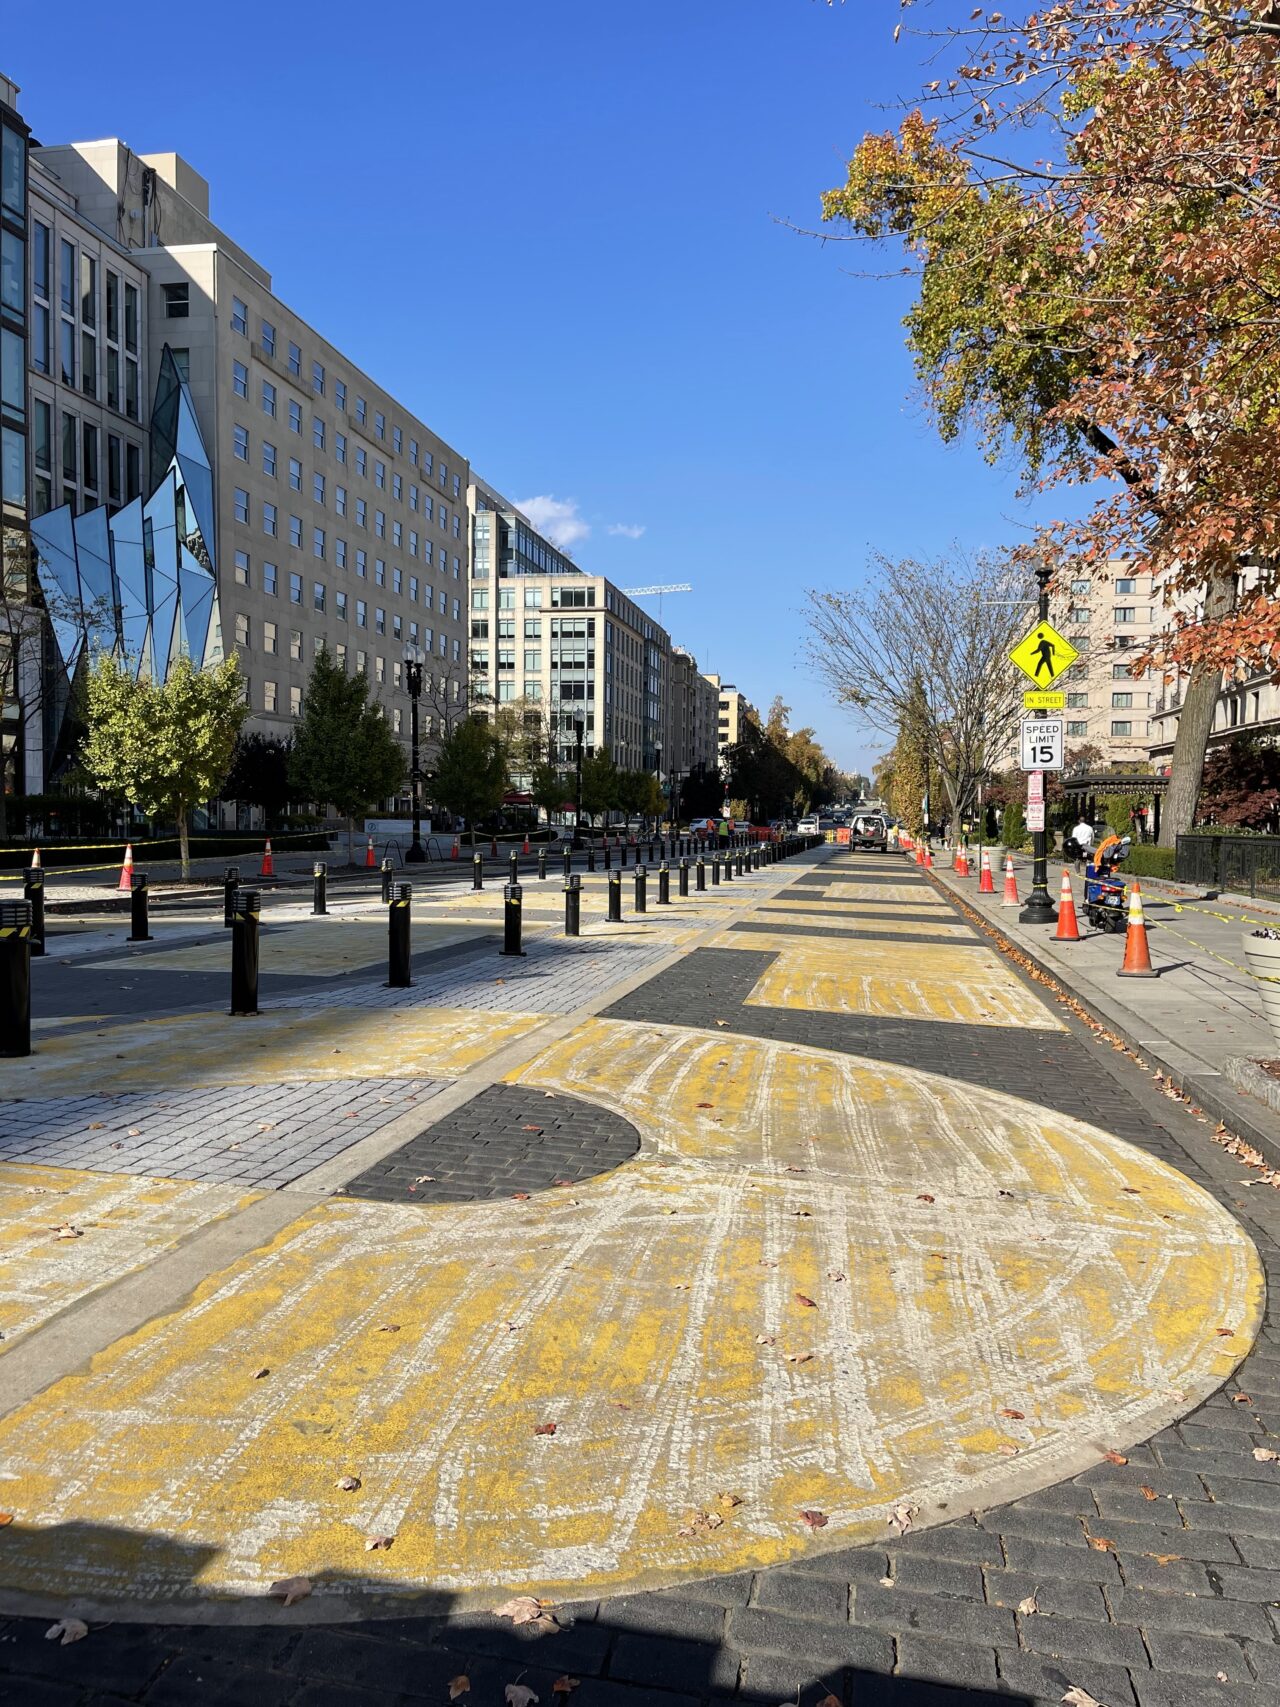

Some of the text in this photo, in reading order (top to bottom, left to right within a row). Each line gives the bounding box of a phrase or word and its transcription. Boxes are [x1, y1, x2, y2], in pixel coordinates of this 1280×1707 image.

[1038, 696, 1062, 704] STREET
[1026, 725, 1059, 734] SPEED
[1029, 735, 1055, 743] LIMIT
[1031, 746, 1053, 763] 15
